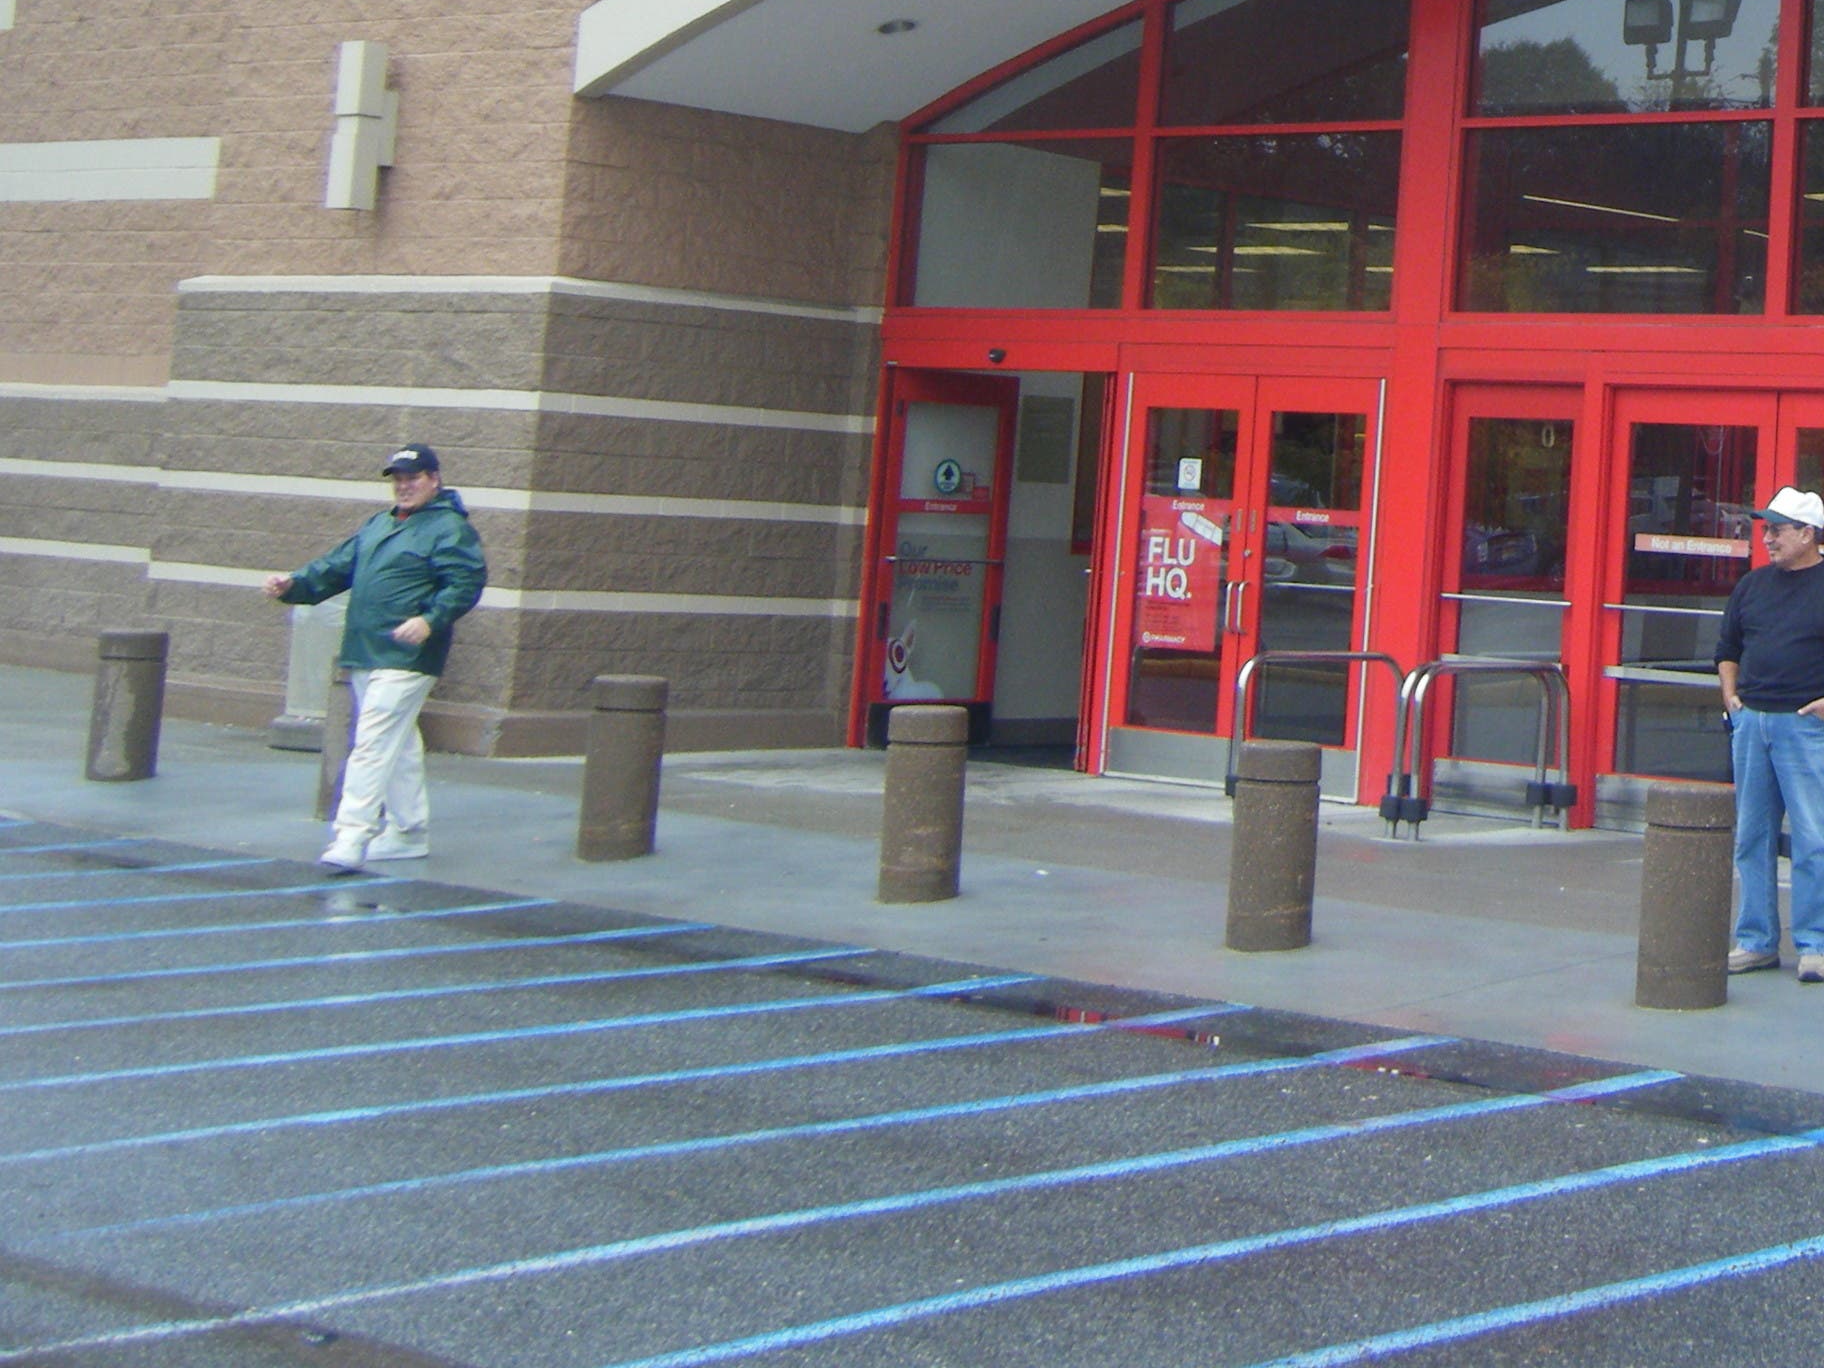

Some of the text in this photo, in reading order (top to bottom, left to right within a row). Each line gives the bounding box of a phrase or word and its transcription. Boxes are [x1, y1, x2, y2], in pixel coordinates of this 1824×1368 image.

[1172, 499, 1205, 511] Entrance
[1296, 510, 1330, 522] Entrance
[1148, 536, 1196, 567] FLU
[1651, 537, 1732, 554] Not an Entrance
[1146, 567, 1192, 600] HQ.
